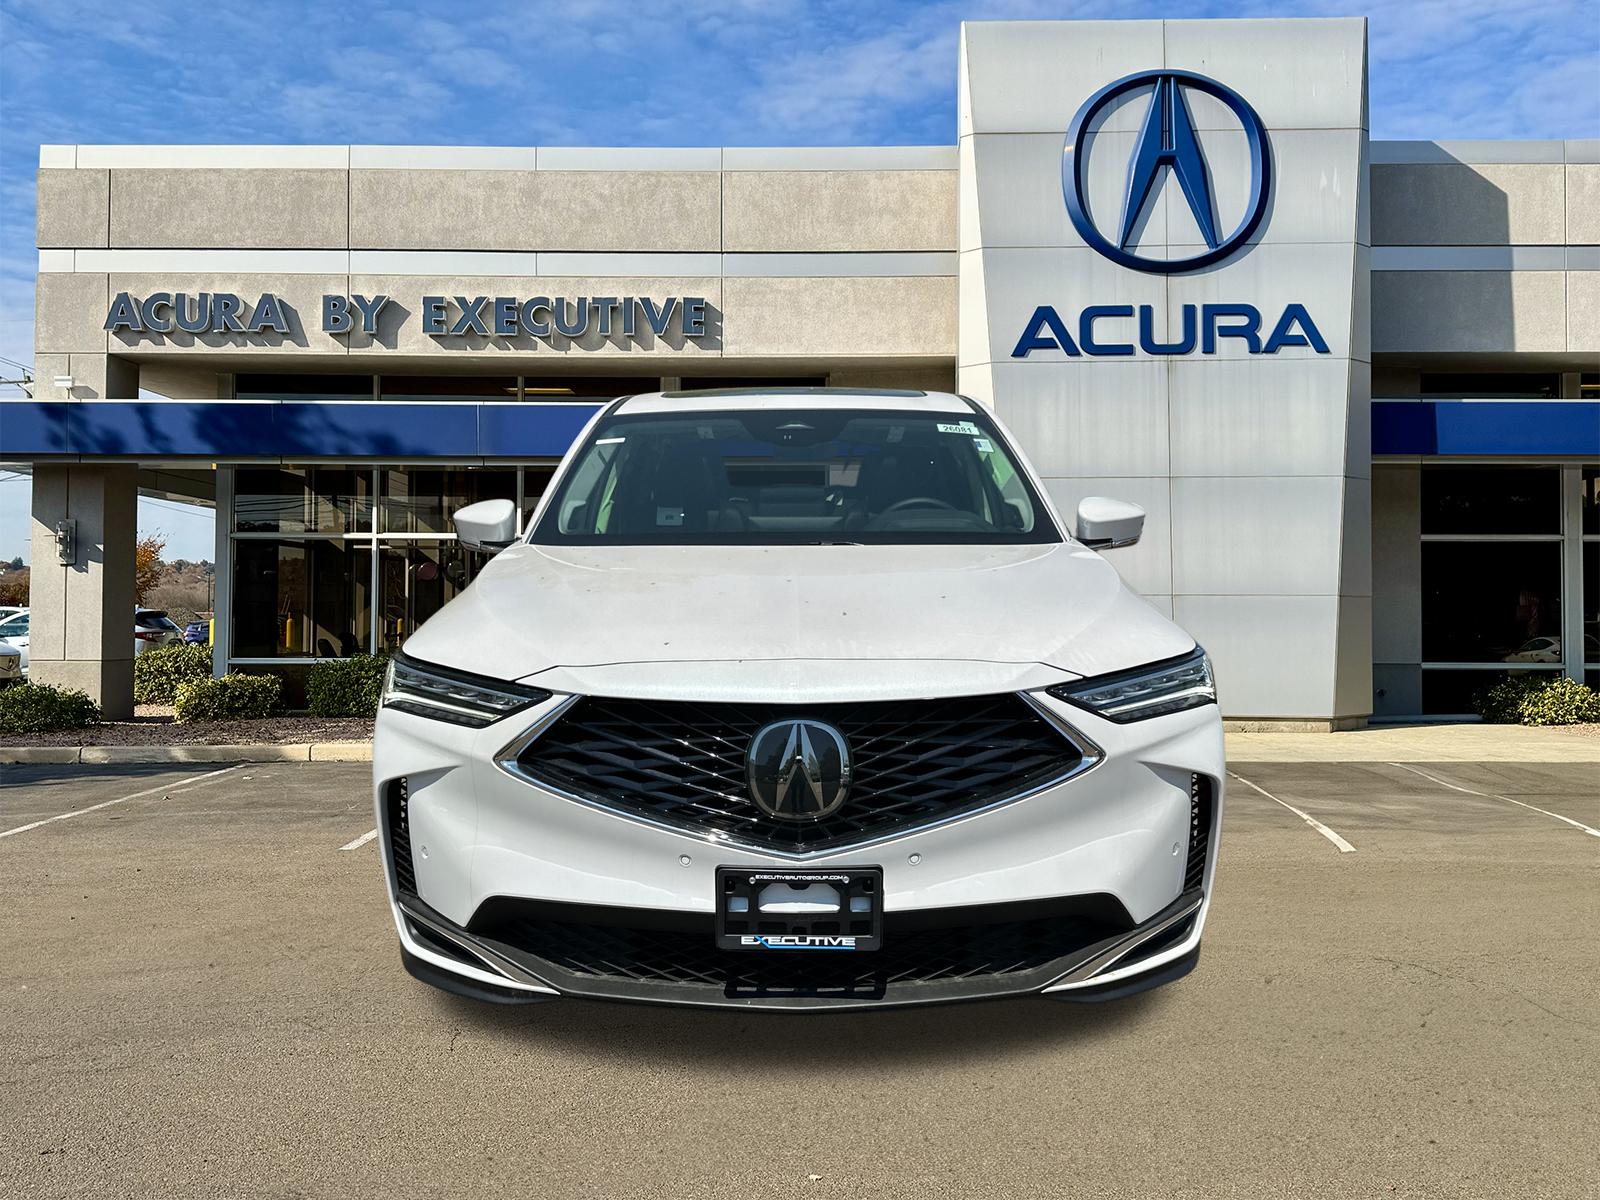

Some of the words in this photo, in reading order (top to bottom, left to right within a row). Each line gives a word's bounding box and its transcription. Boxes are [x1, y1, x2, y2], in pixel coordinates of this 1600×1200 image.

[103, 292, 290, 334] ACURA
[322, 295, 391, 334] BY
[422, 296, 706, 337] EXECUTIVE
[1011, 303, 1331, 357] ACURA
[943, 425, 972, 433] 26081
[741, 936, 856, 947] EXECUTIVE
